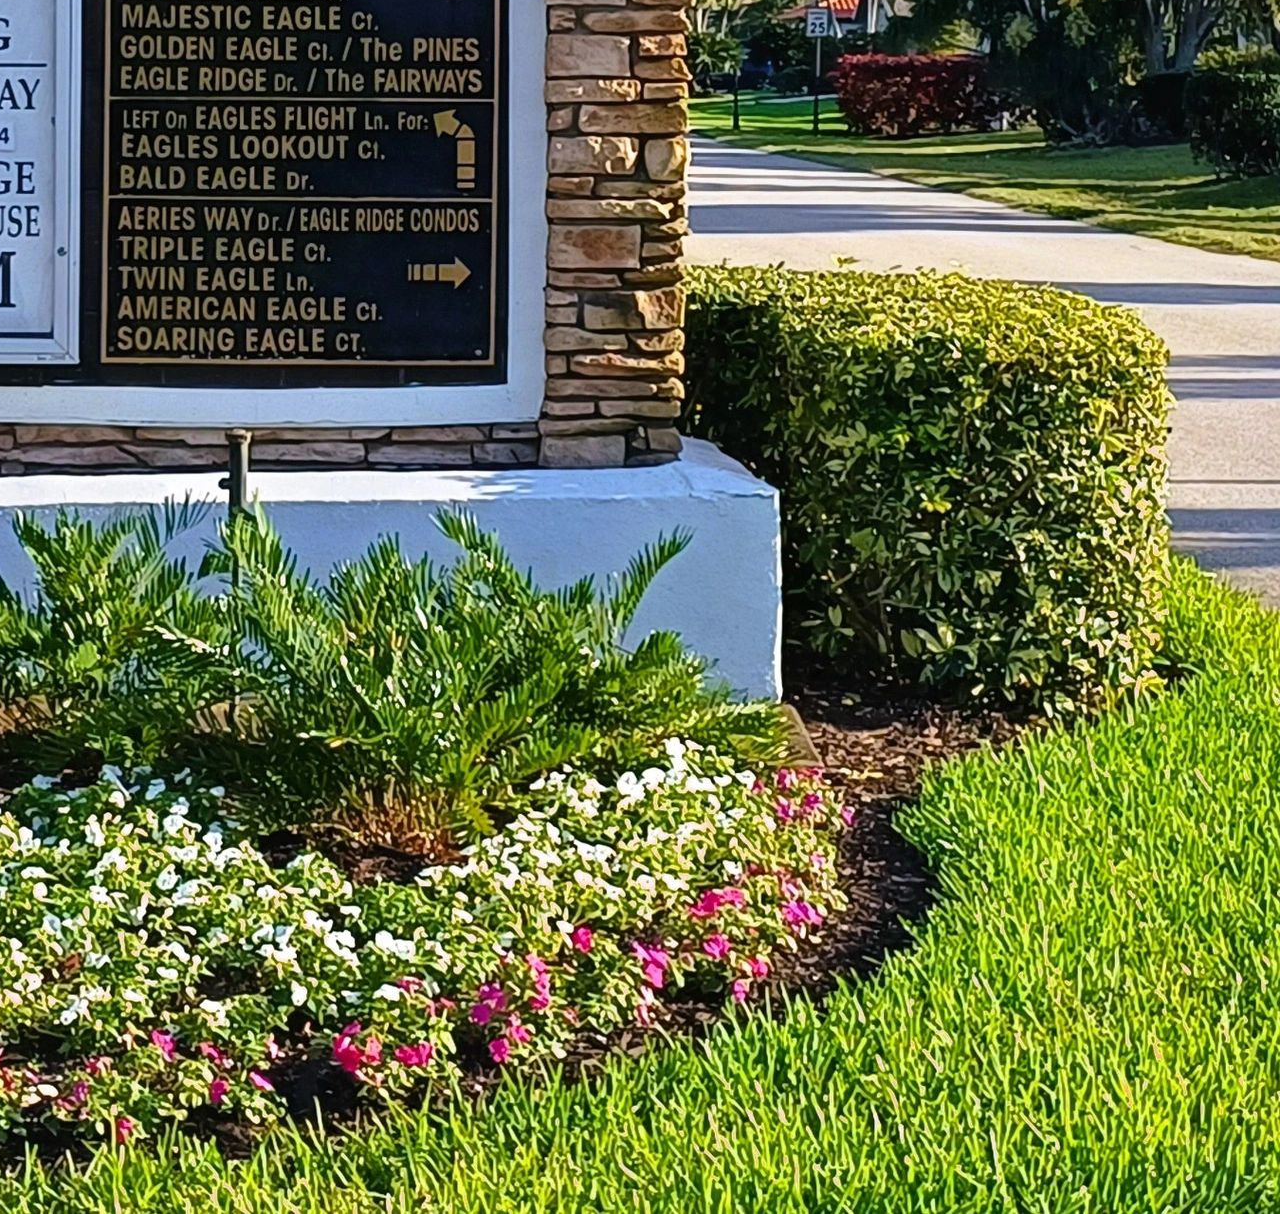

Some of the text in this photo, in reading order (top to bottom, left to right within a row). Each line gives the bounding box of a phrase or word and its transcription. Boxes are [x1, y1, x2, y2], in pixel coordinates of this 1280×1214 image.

[122, 5, 379, 31] MAJESTIC EAGLE Ct.
[810, 22, 825, 34] 25
[120, 35, 214, 60] GOLDEN
[226, 36, 297, 61] EAGLE
[360, 37, 402, 63] The
[413, 38, 480, 63] PINES
[120, 66, 188, 91] EAGLE
[199, 67, 267, 92] RIDGE
[274, 72, 298, 92] Dr.
[324, 68, 365, 92] The
[374, 68, 482, 94] FAIRWAYS
[123, 109, 160, 130] LEFT
[165, 110, 187, 130] On
[196, 106, 277, 131] EAGLES
[284, 106, 357, 131] FLIGHT
[365, 111, 389, 131] Ln.
[121, 133, 218, 159] EAGLES
[229, 135, 349, 160] LOOKOUT
[120, 165, 314, 190] BALD EAGLE Dr.
[118, 206, 196, 231] AERIES
[204, 207, 254, 232] WAY
[300, 207, 349, 232] EAGLE
[356, 207, 404, 233] RIDGE
[410, 208, 480, 233] CONDOS
[119, 236, 332, 262] TRIPLE EAGLE Ct.
[119, 266, 315, 292] TWIN EAGLE Ln.
[118, 296, 383, 321] AMERICAN EAGLE Ct.
[117, 326, 366, 352] SOARING EAGLE CT.
